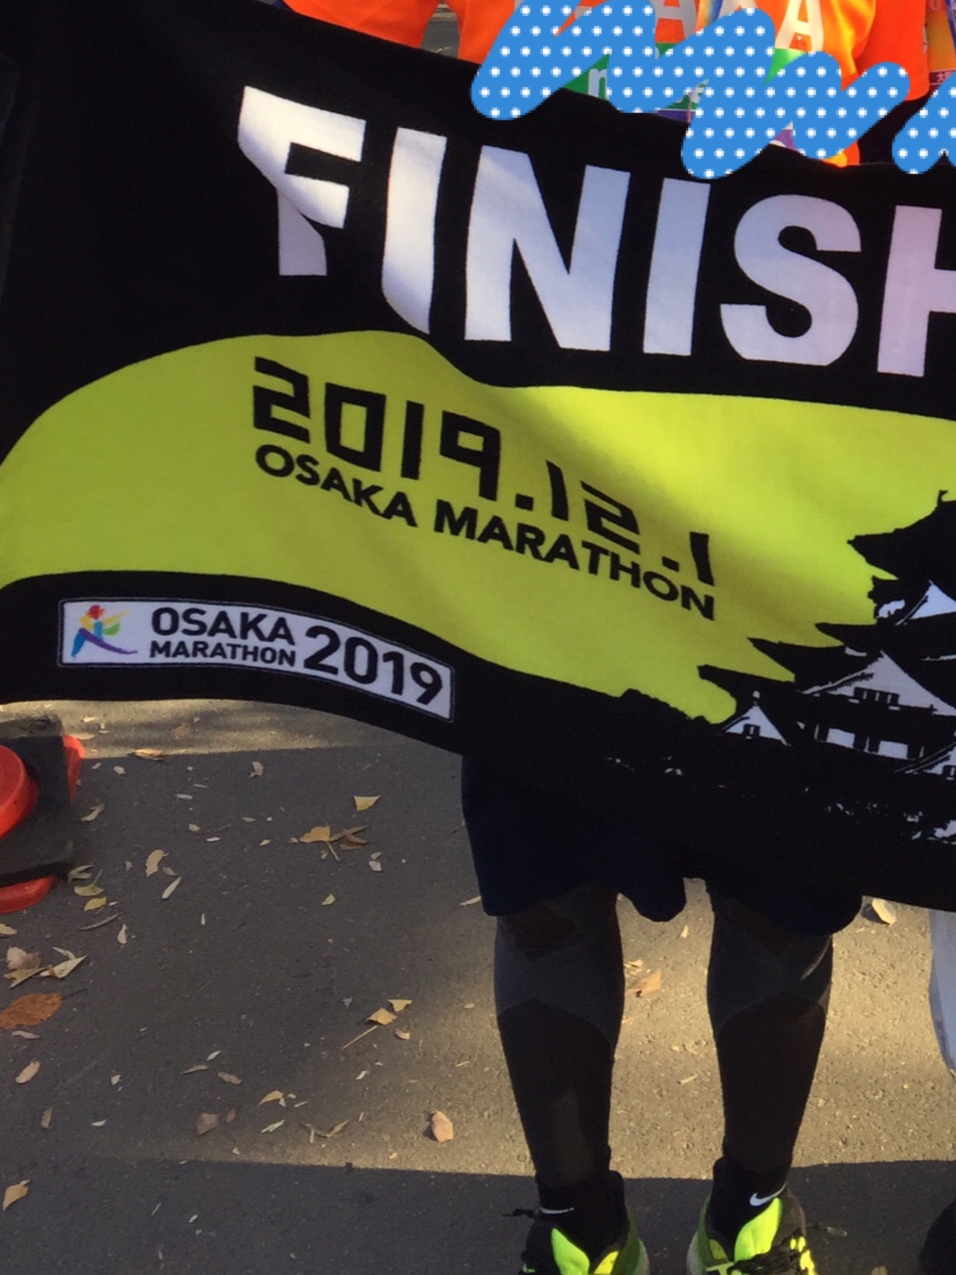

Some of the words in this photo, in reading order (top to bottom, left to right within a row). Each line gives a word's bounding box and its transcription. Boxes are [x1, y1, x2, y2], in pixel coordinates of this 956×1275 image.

[253, 356, 715, 586] 2019.12.1
[254, 443, 417, 529] OSAKA
[433, 500, 716, 622] MARATHON
[149, 639, 297, 668] MARATHON
[150, 605, 296, 647] OSAKA
[303, 625, 442, 707] 2019
